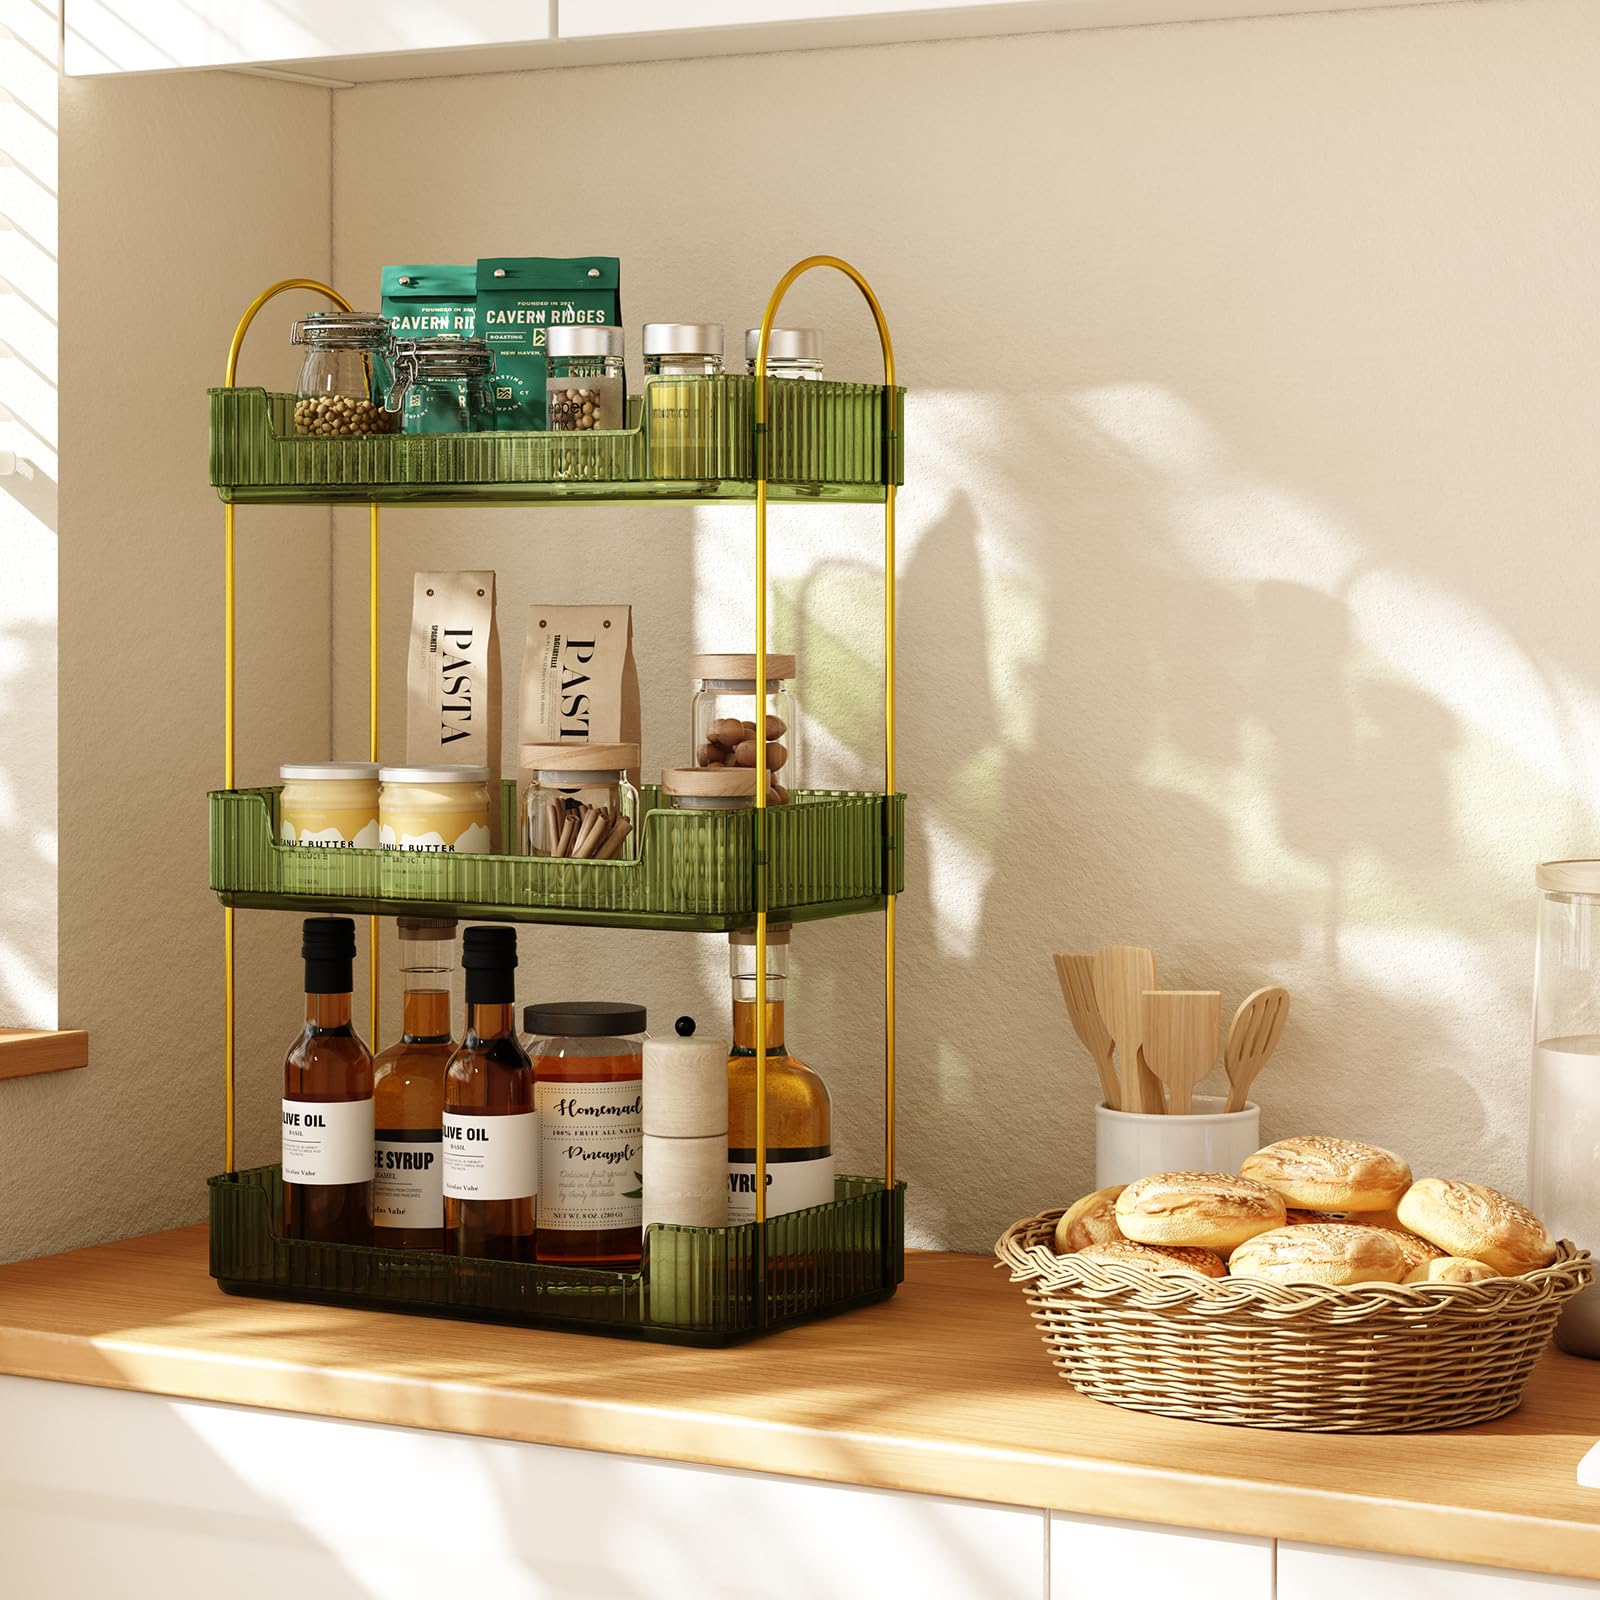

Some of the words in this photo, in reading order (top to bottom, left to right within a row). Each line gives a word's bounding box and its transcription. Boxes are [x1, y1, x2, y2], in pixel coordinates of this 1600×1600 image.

[391, 316, 449, 330] CAVERN
[486, 310, 546, 324] CAVERN
[551, 309, 605, 324] RIDGES
[430, 625, 439, 653] SPAGHETTI
[550, 634, 561, 669] TAGLIATELLE
[441, 625, 473, 747] PASTA
[308, 840, 354, 848] BUTTER
[282, 1112, 301, 1126] LIVE
[304, 1114, 327, 1128] OIL
[443, 1124, 463, 1140] LIVE
[466, 1127, 489, 1142] OIL
[619, 1127, 643, 1135] NATUR
[386, 1151, 434, 1170] SYRUP
[561, 1143, 637, 1164] Pineapple
